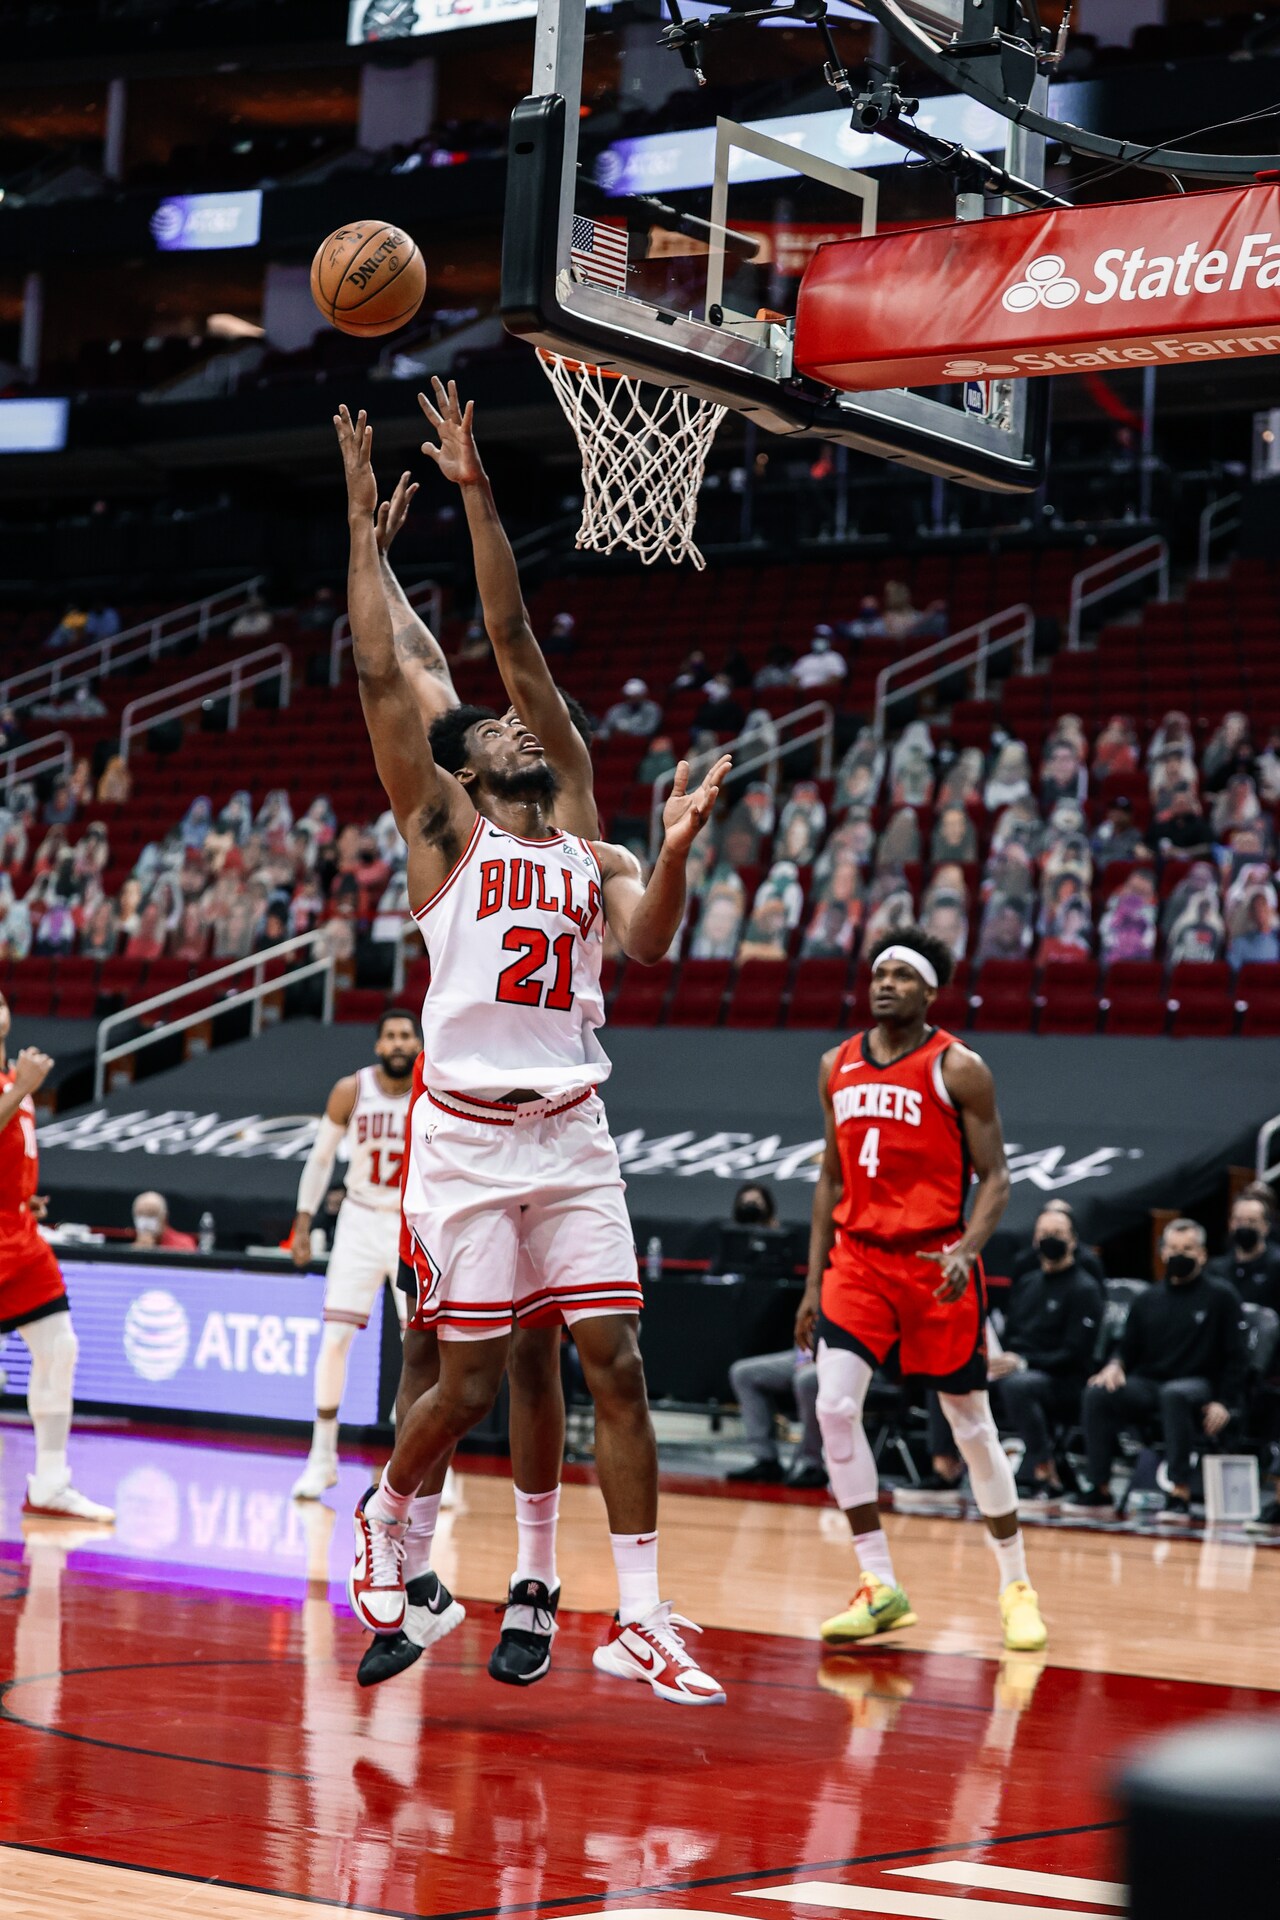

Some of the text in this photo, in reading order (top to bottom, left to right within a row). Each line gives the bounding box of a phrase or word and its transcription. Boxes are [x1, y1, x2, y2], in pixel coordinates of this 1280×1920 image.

[476, 858, 602, 941] BULLS
[495, 925, 575, 1012] 21
[858, 1127, 880, 1178] 4
[195, 1312, 320, 1377] AT&T
